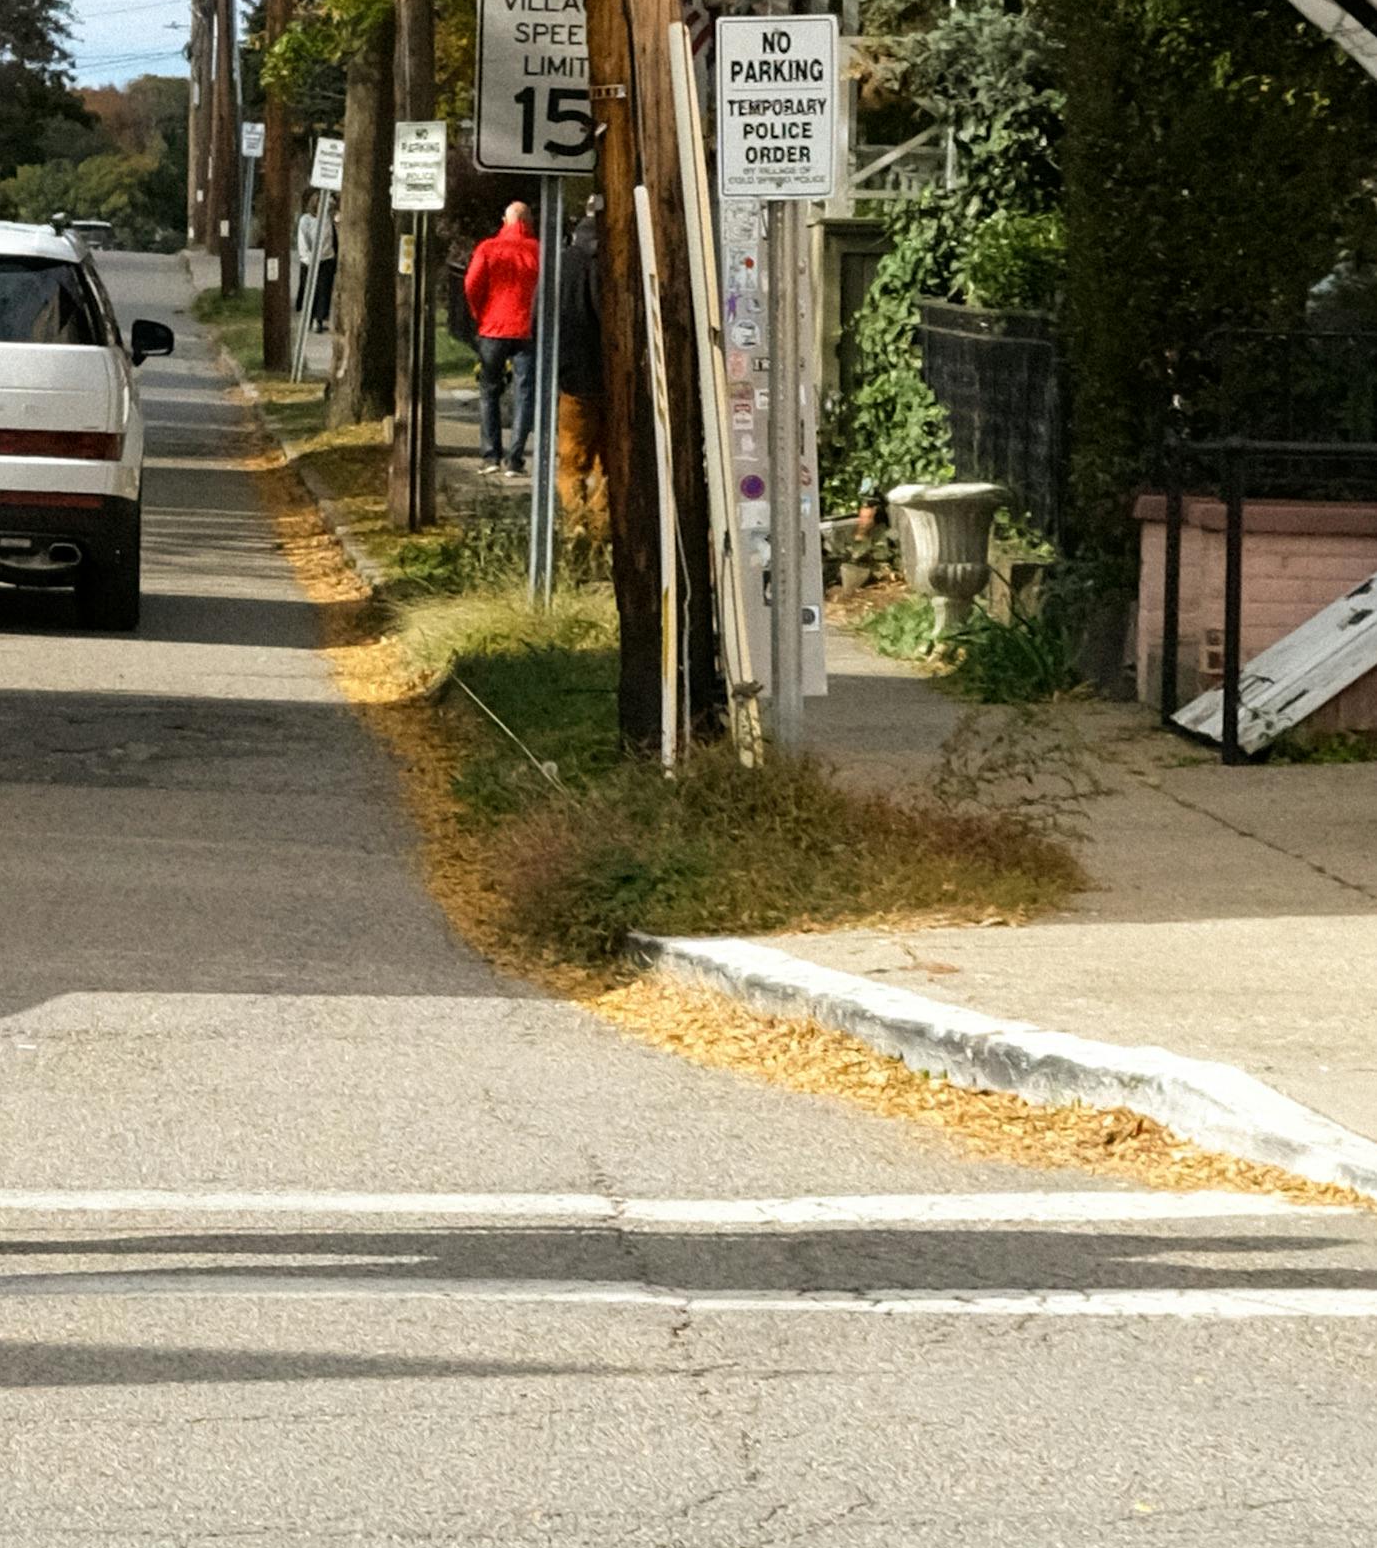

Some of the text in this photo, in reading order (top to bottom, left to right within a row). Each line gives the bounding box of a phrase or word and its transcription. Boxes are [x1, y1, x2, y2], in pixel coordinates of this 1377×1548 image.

[514, 22, 584, 45] SPEE
[762, 31, 791, 54] NO
[523, 55, 589, 78] LIMIT
[730, 59, 824, 83] PARKING
[727, 98, 827, 116] TEMPORARY
[514, 86, 596, 157] 15
[743, 122, 813, 140] POLICE
[745, 146, 811, 164] ORDER
